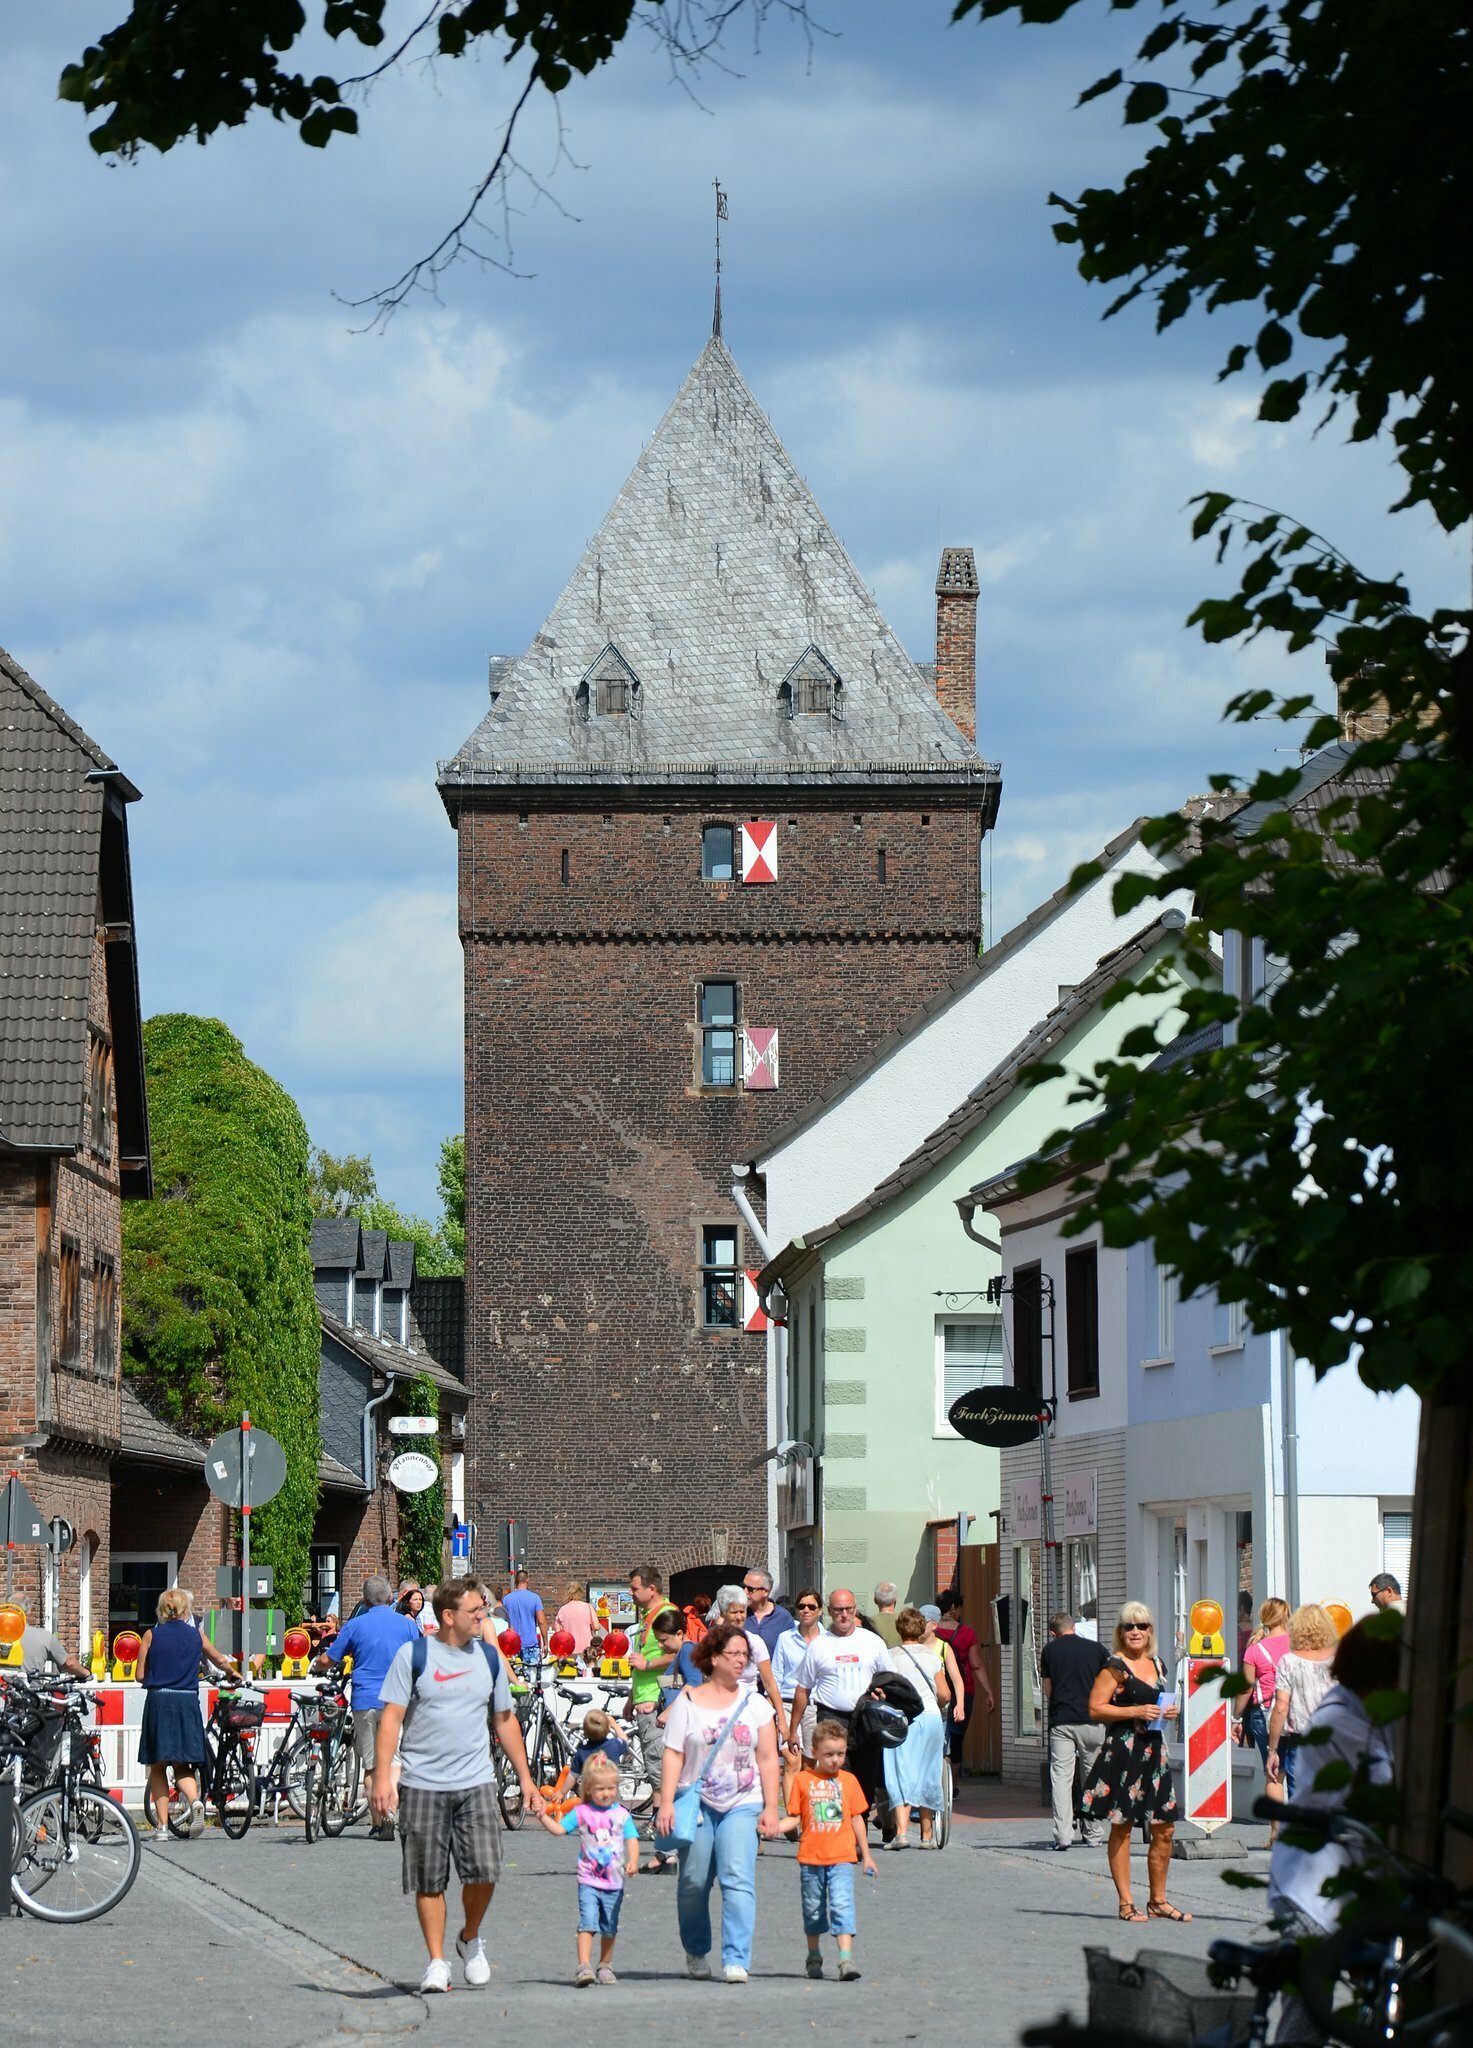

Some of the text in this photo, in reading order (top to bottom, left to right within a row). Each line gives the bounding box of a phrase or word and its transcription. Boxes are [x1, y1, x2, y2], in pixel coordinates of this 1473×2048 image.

[953, 1406, 1038, 1425] FachZimme
[392, 1455, 434, 1472] Pfannenhof
[810, 1822, 842, 1832] 1977
